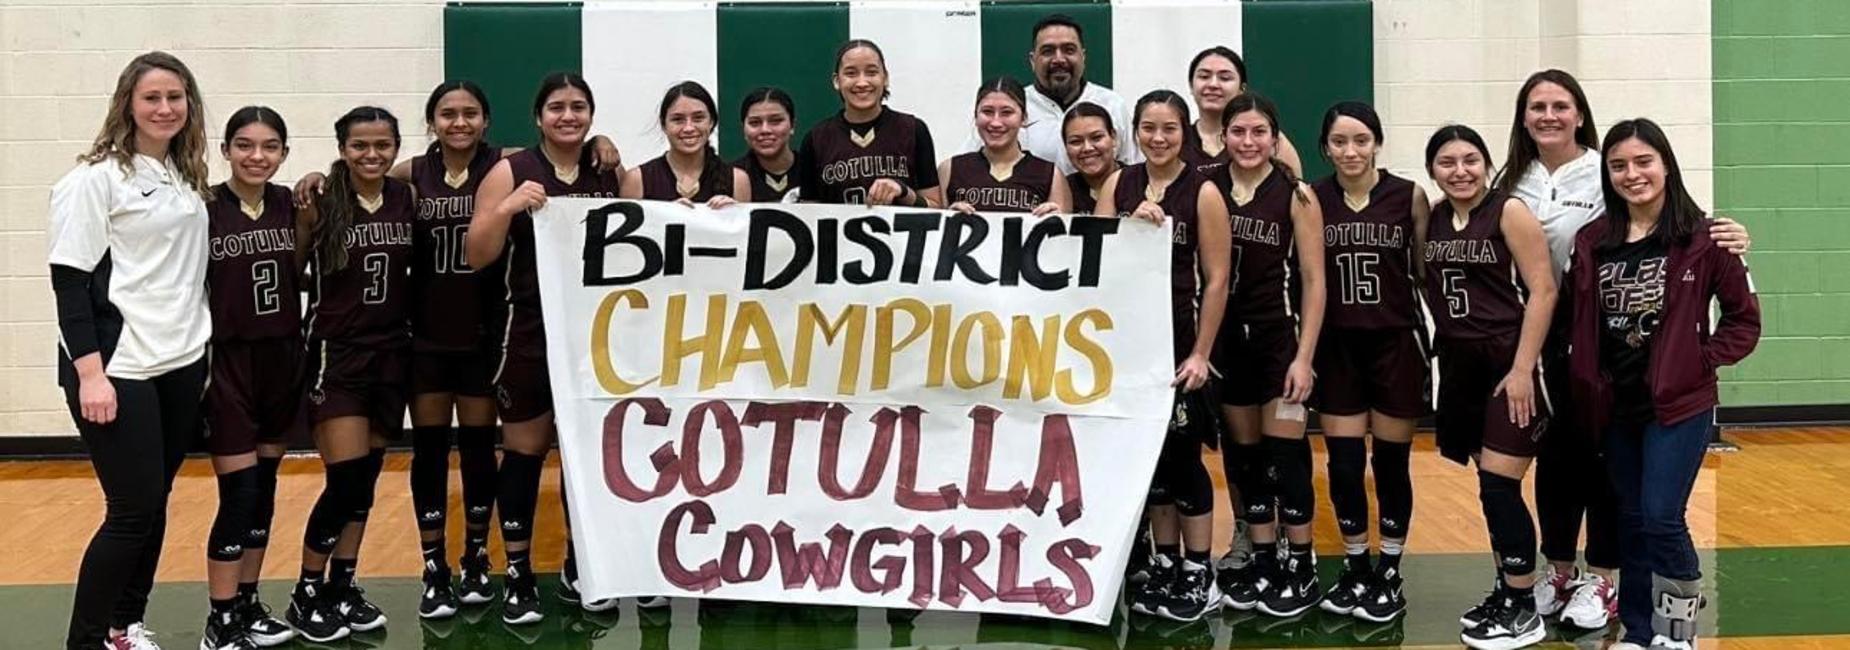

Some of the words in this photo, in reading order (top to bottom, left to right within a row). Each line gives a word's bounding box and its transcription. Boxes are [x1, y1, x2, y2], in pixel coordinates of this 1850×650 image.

[822, 155, 909, 184] COTULLA
[417, 195, 475, 220] OTUL
[210, 228, 295, 260] COTULL
[1325, 222, 1403, 249] OTULLA
[1424, 239, 1498, 263] OTULLA
[252, 259, 280, 315] 2
[363, 252, 389, 304] 3
[1336, 252, 1380, 304] 15
[1442, 268, 1469, 318] 5
[591, 289, 1113, 404] CHAMPIONS
[602, 398, 1084, 527] COTULLA
[658, 500, 1102, 615] COWGIRLS
